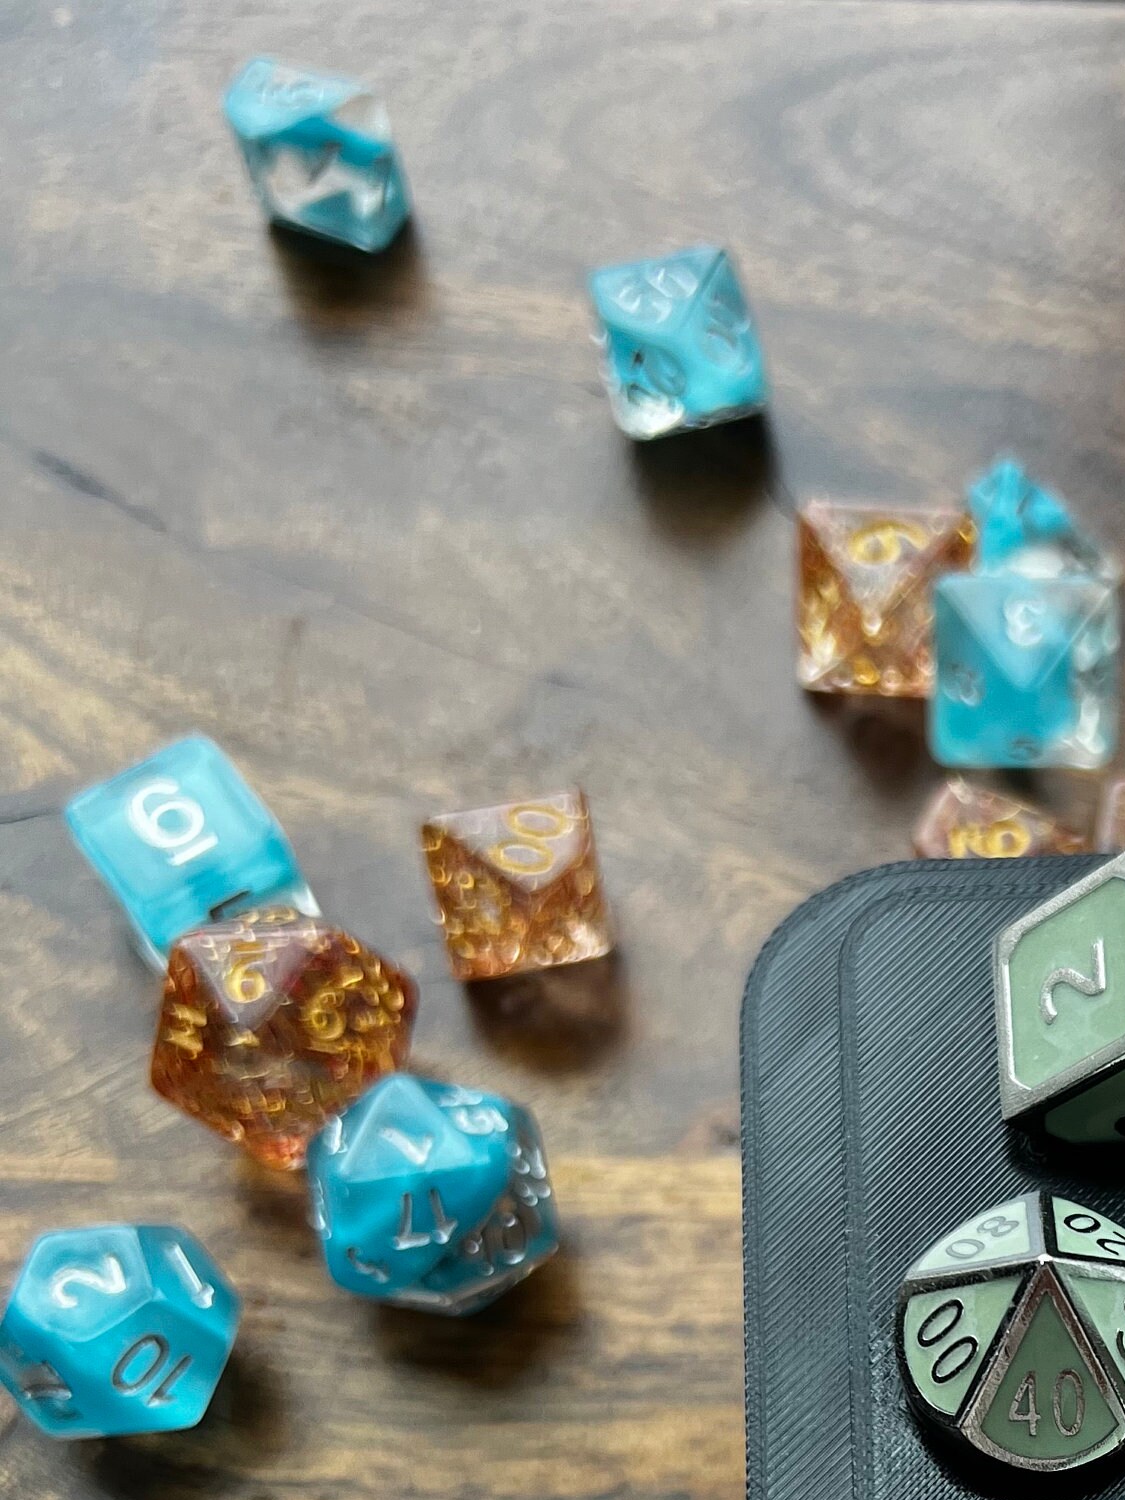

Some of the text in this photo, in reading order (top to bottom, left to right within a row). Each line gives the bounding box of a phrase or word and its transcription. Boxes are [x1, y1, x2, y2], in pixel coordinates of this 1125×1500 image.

[1041, 938, 1106, 1026] 2
[944, 1215, 1020, 1260] 80
[51, 1253, 127, 1309] 2
[112, 1332, 193, 1408] 10
[916, 1298, 980, 1385] 00
[1008, 1368, 1086, 1437] 40
